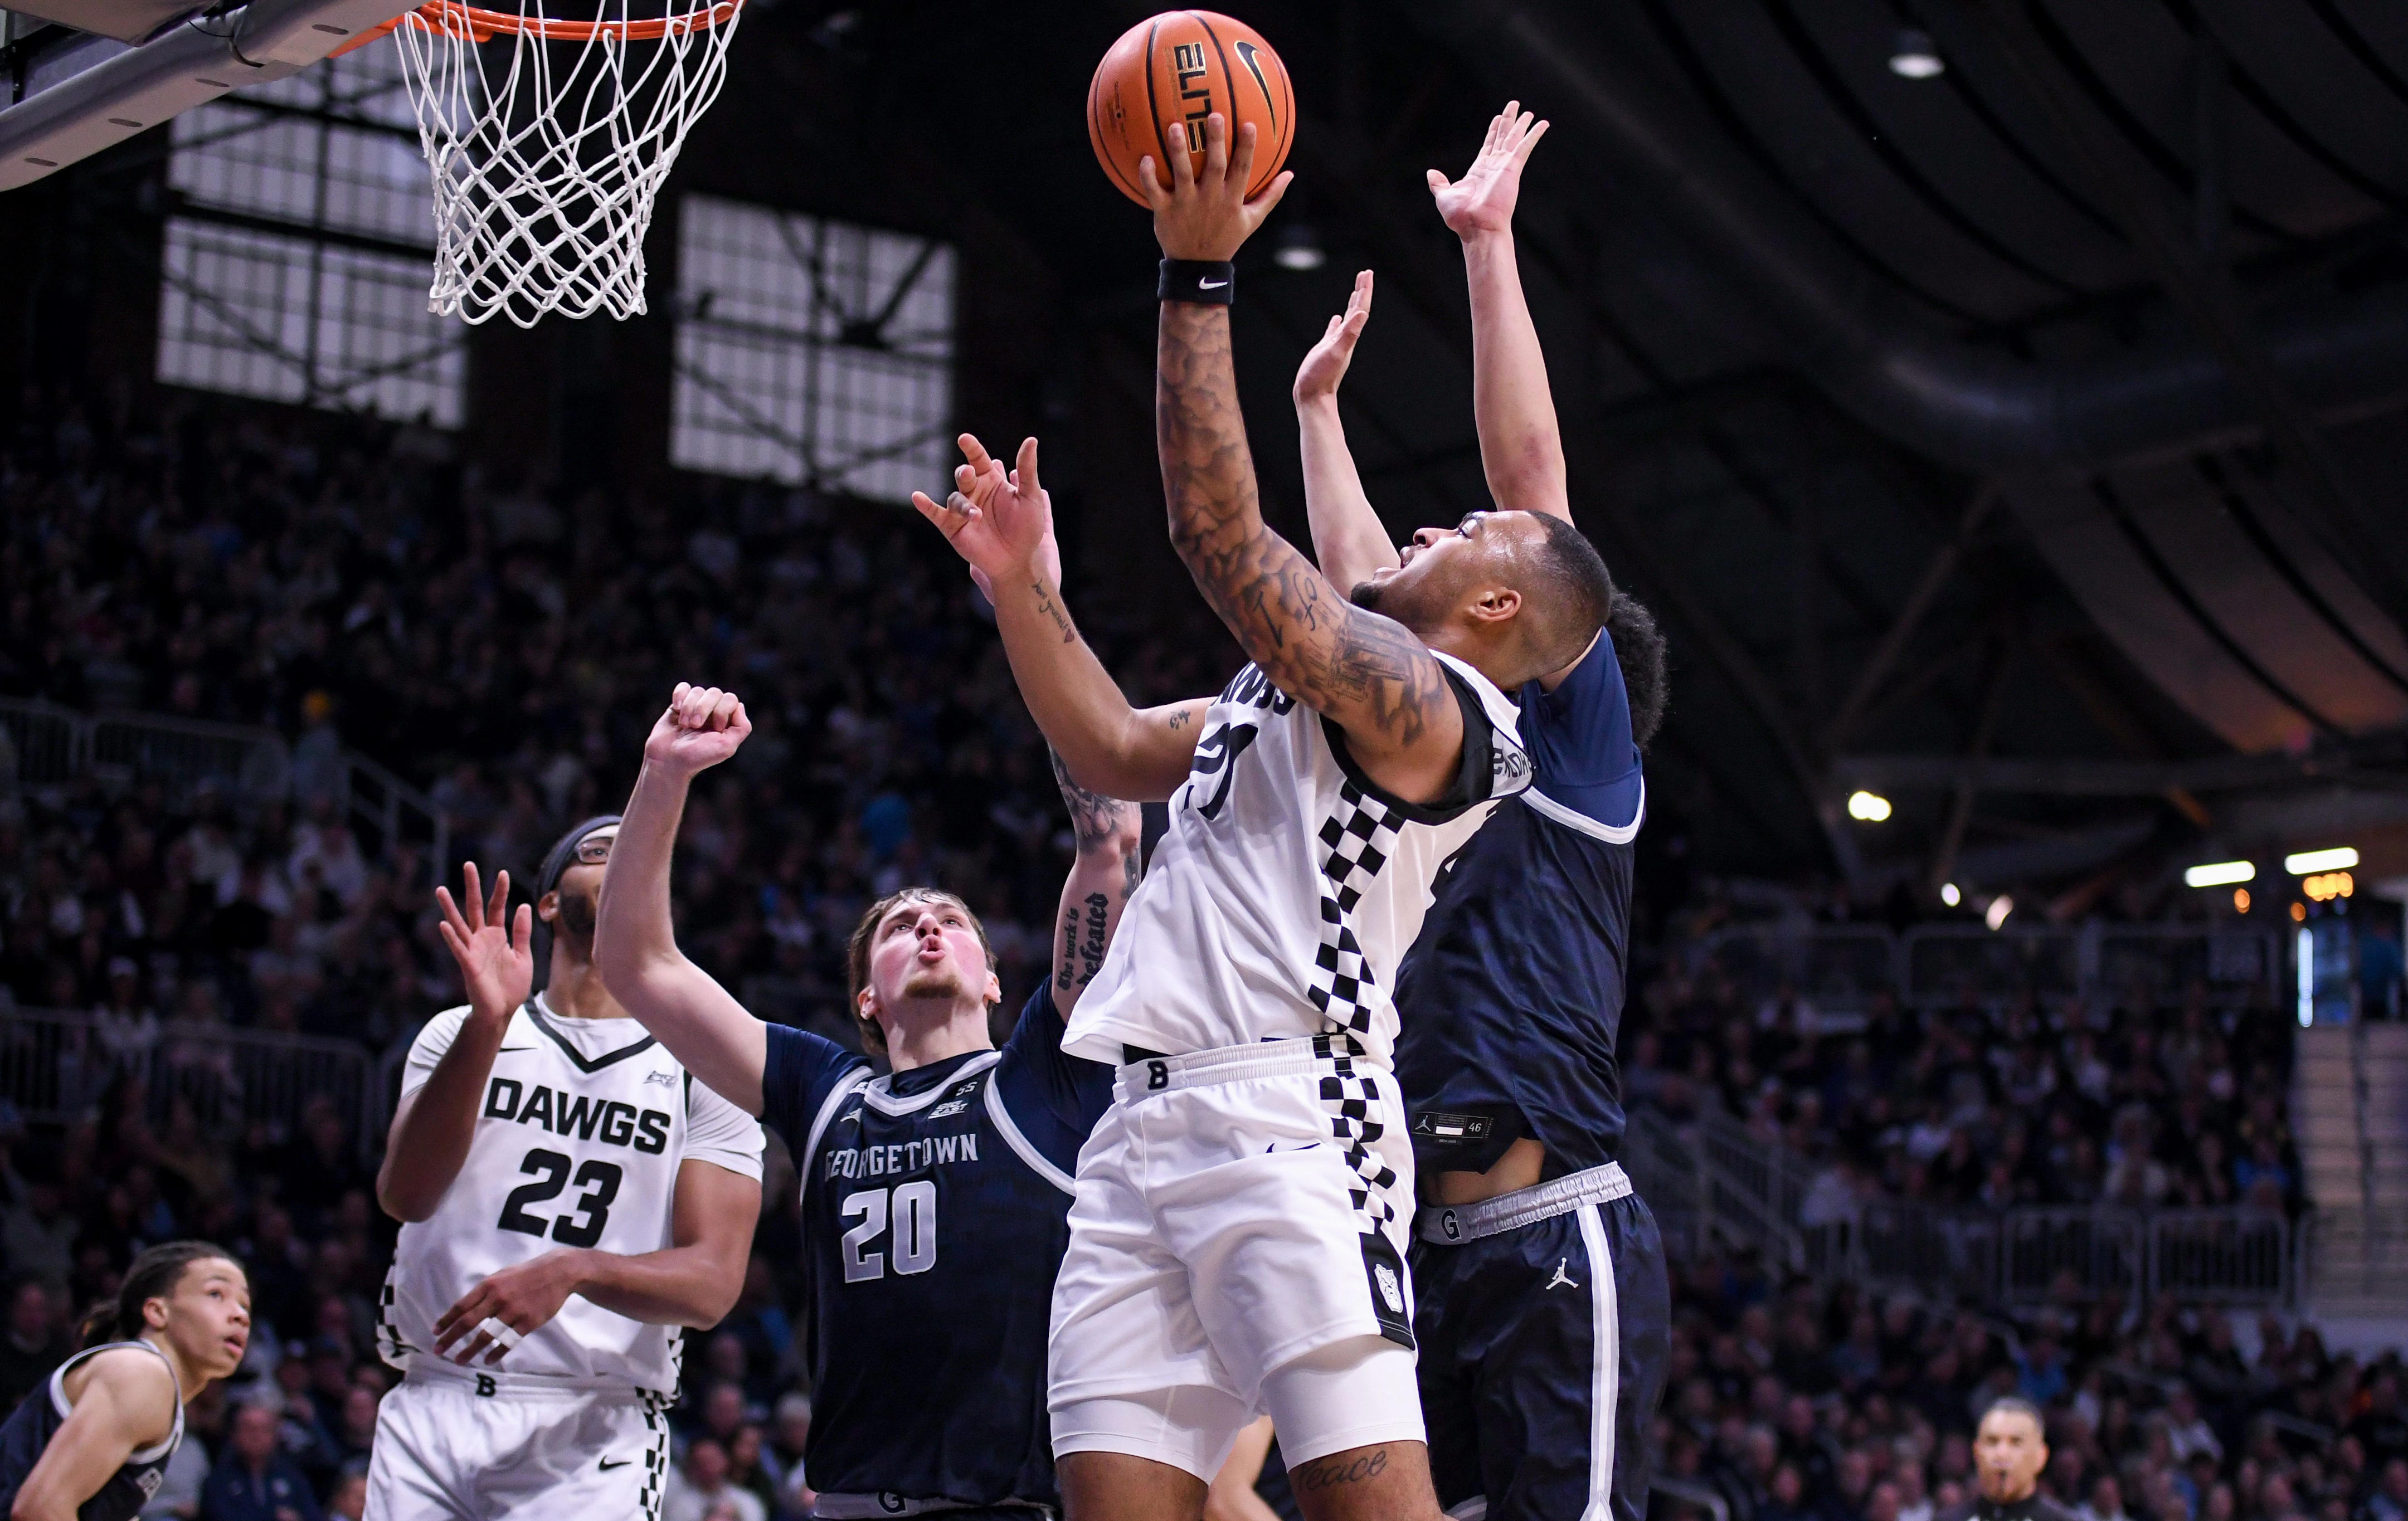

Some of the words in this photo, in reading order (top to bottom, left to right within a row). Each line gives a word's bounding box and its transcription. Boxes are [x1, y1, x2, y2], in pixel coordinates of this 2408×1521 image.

[1174, 41, 1213, 154] ELITE
[1146, 1059, 1169, 1091] B
[484, 1078, 671, 1156] DAWGS
[931, 1103, 968, 1115] EAST
[1468, 1122, 1482, 1132] 46
[824, 1133, 979, 1182] GEORGETOWN
[497, 1148, 623, 1249] 23
[841, 1180, 937, 1284] 20
[1441, 1208, 1462, 1242] G
[475, 1373, 497, 1397] B
